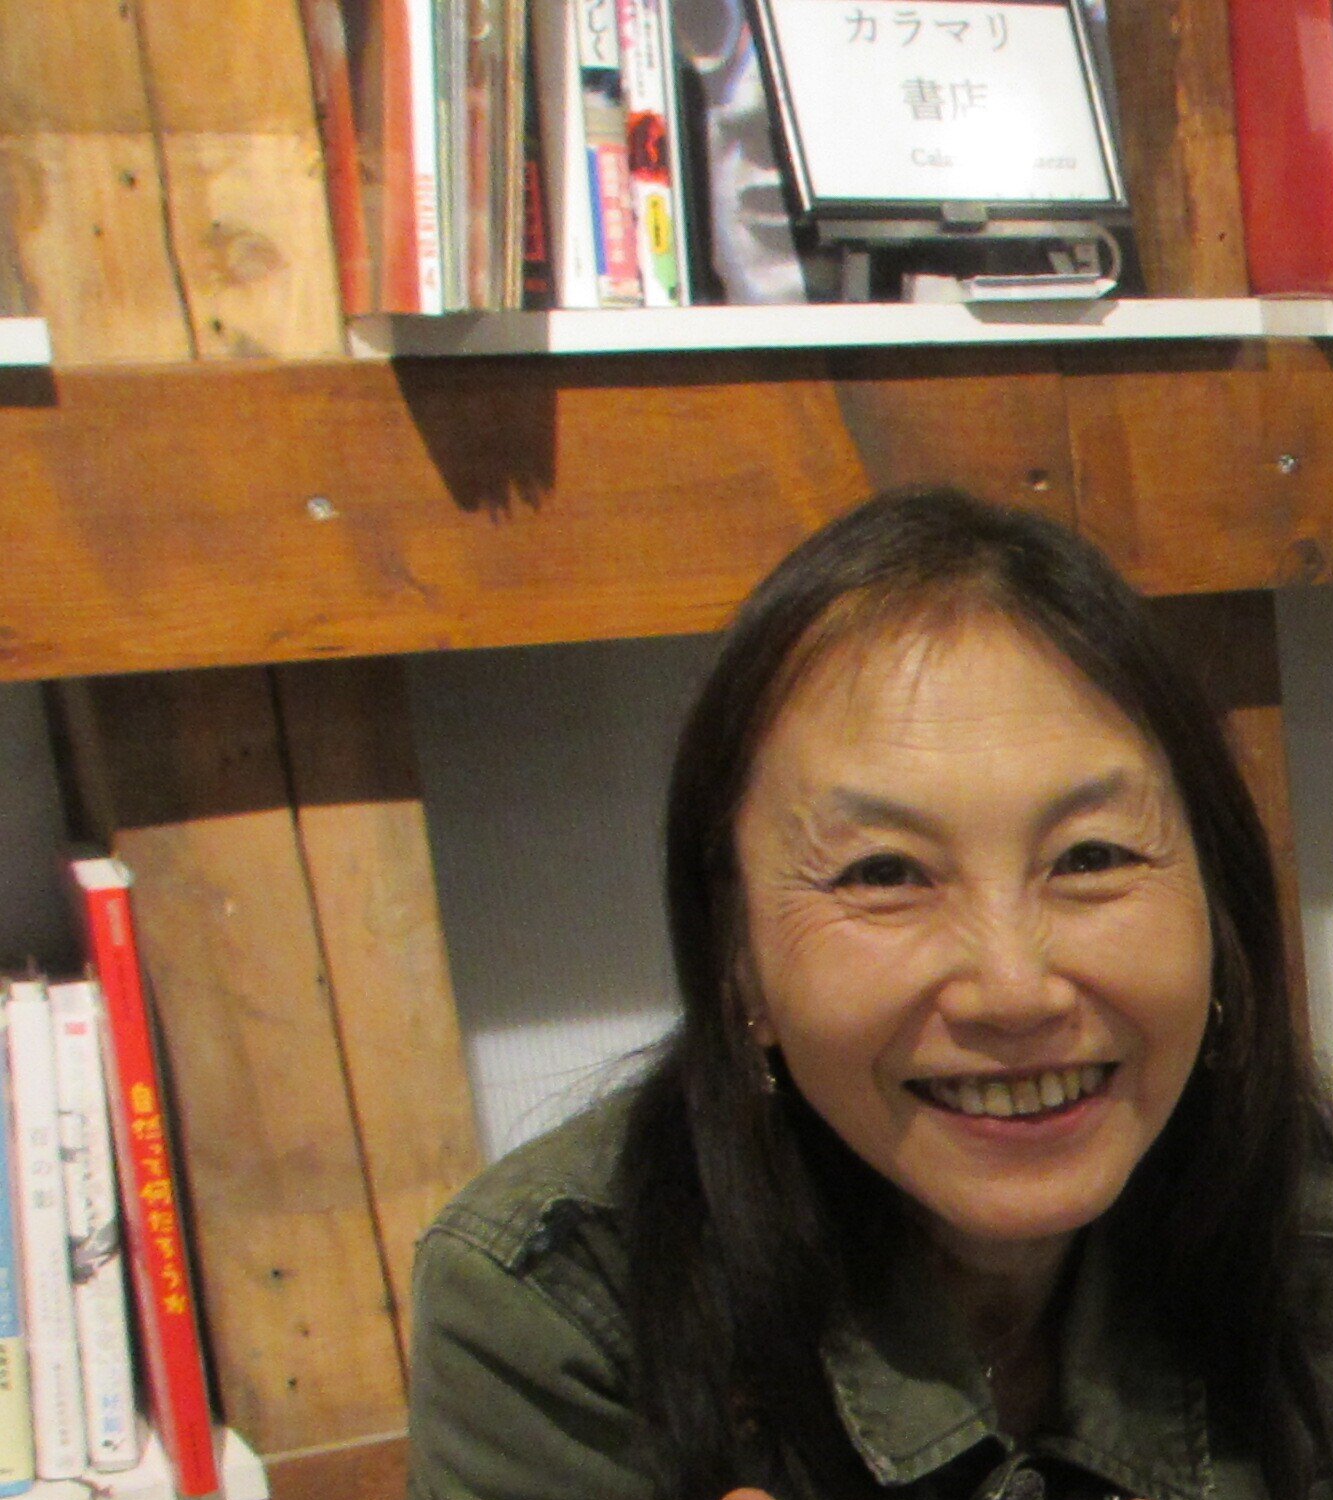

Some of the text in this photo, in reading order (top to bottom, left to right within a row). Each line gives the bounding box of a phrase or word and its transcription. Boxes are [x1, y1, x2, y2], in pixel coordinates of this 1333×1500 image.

[845, 8, 1008, 52] カラマリ
[901, 76, 988, 121] 書店
